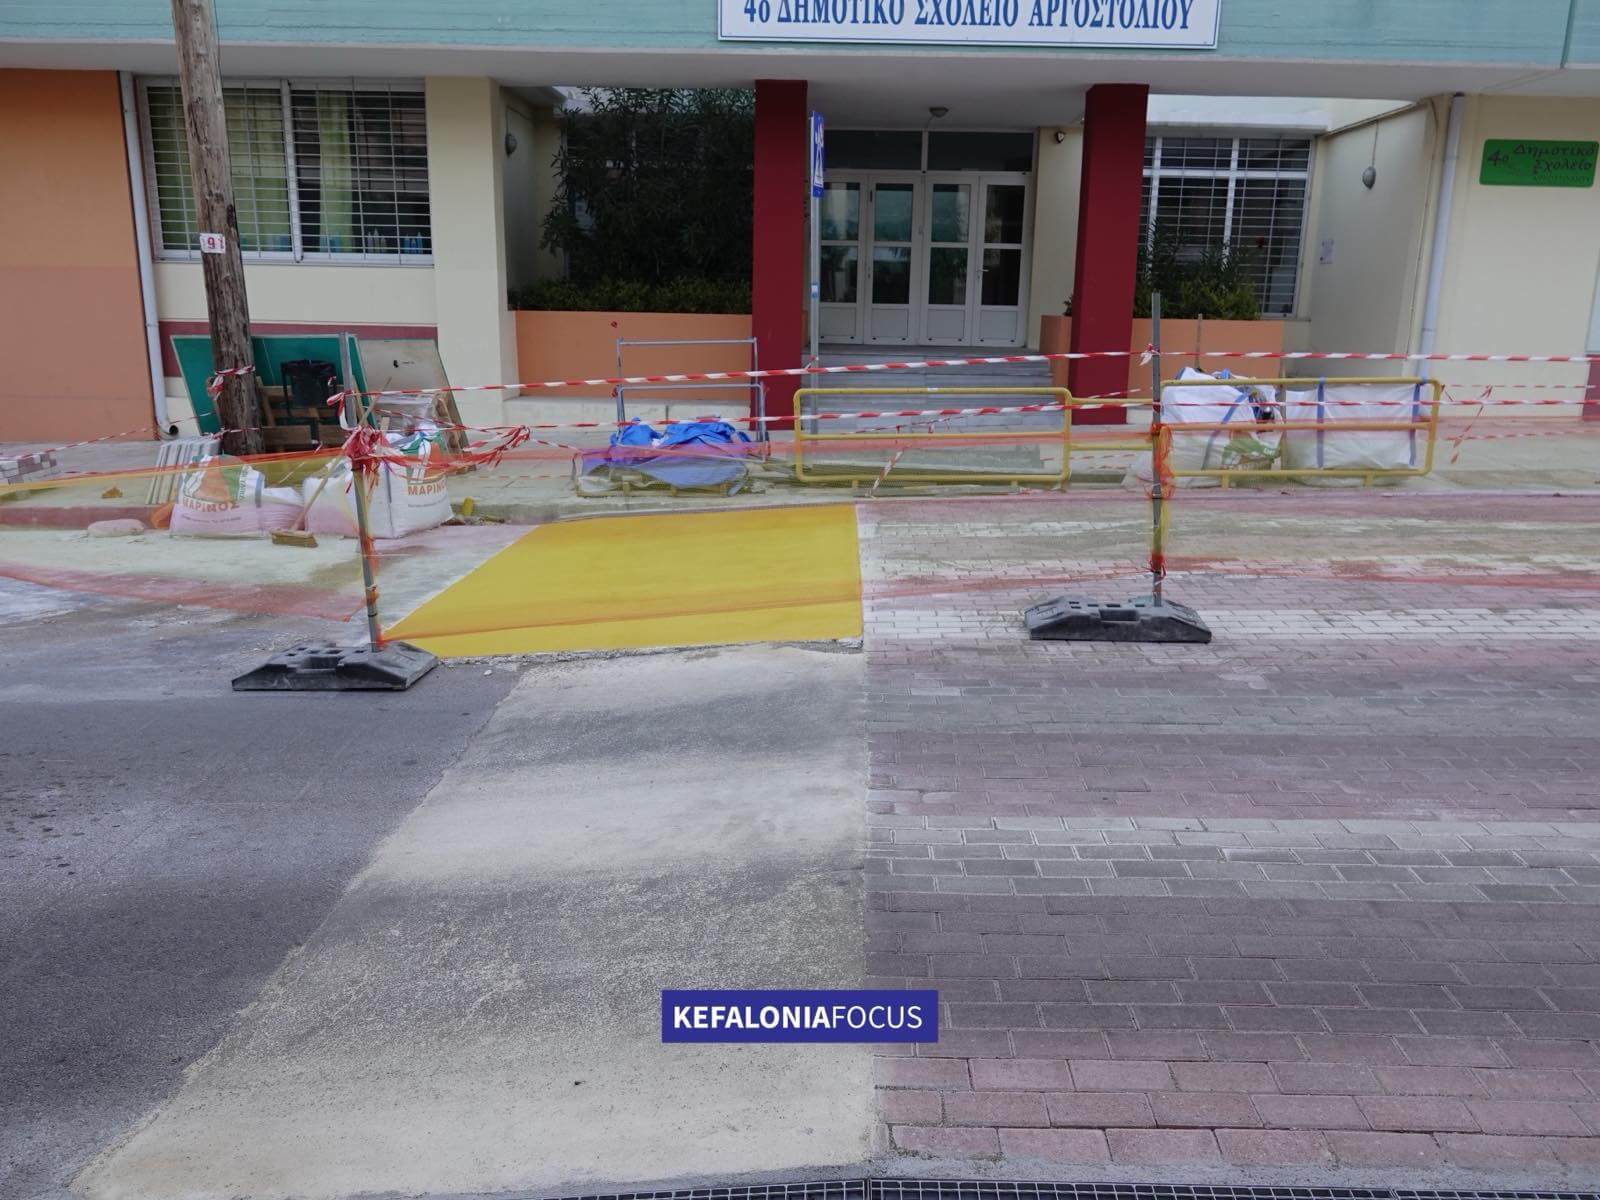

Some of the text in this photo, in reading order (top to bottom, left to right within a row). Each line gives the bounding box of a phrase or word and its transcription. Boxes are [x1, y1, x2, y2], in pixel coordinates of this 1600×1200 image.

[777, 0, 905, 24] ΔΗΜΟΤΙΚΟ
[914, 0, 1018, 27] ΣΧΟΛΕΙΟ
[1028, 0, 1193, 29] ΑΡΓΟΣΤΟΛΙΟΥ
